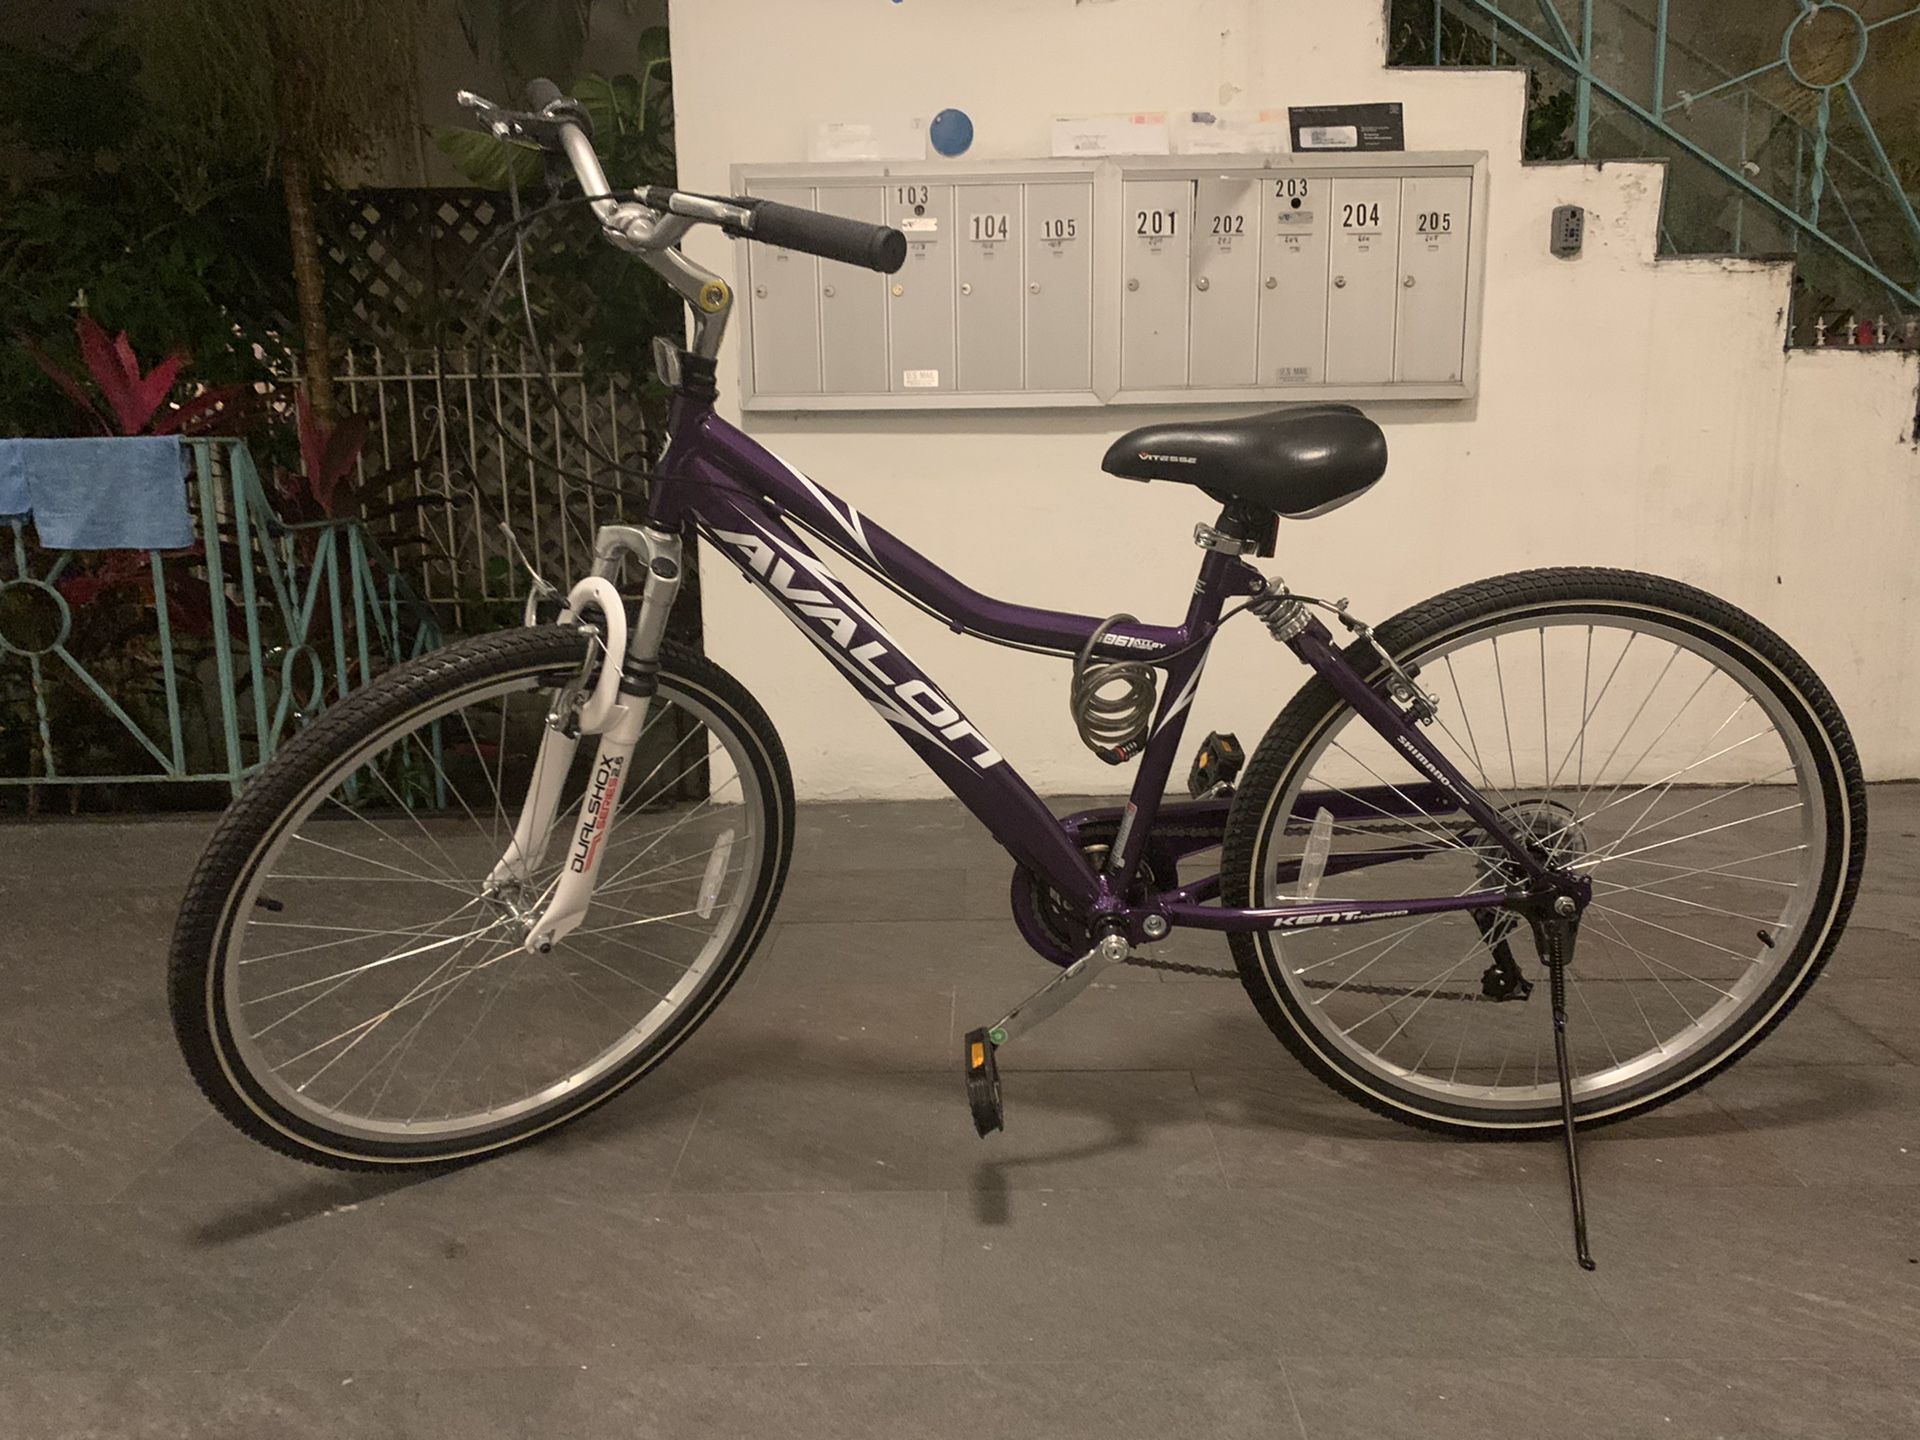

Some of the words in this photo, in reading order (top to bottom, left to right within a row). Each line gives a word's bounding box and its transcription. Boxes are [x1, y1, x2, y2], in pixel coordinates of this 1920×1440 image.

[897, 185, 929, 205] 103
[1275, 178, 1308, 198] 203
[1137, 210, 1176, 235] 201
[1212, 215, 1244, 234] 202
[1342, 203, 1380, 228] 204
[1418, 211, 1451, 232] 205
[973, 215, 1008, 240] 104
[1044, 219, 1076, 237] 105
[1138, 452, 1197, 464] VITESSE
[710, 528, 1003, 770] AVALON
[1397, 735, 1450, 786] SHIMANO
[570, 754, 614, 874] DUALSHOX
[595, 776, 619, 830] SERIES
[1273, 910, 1361, 927] KENT
